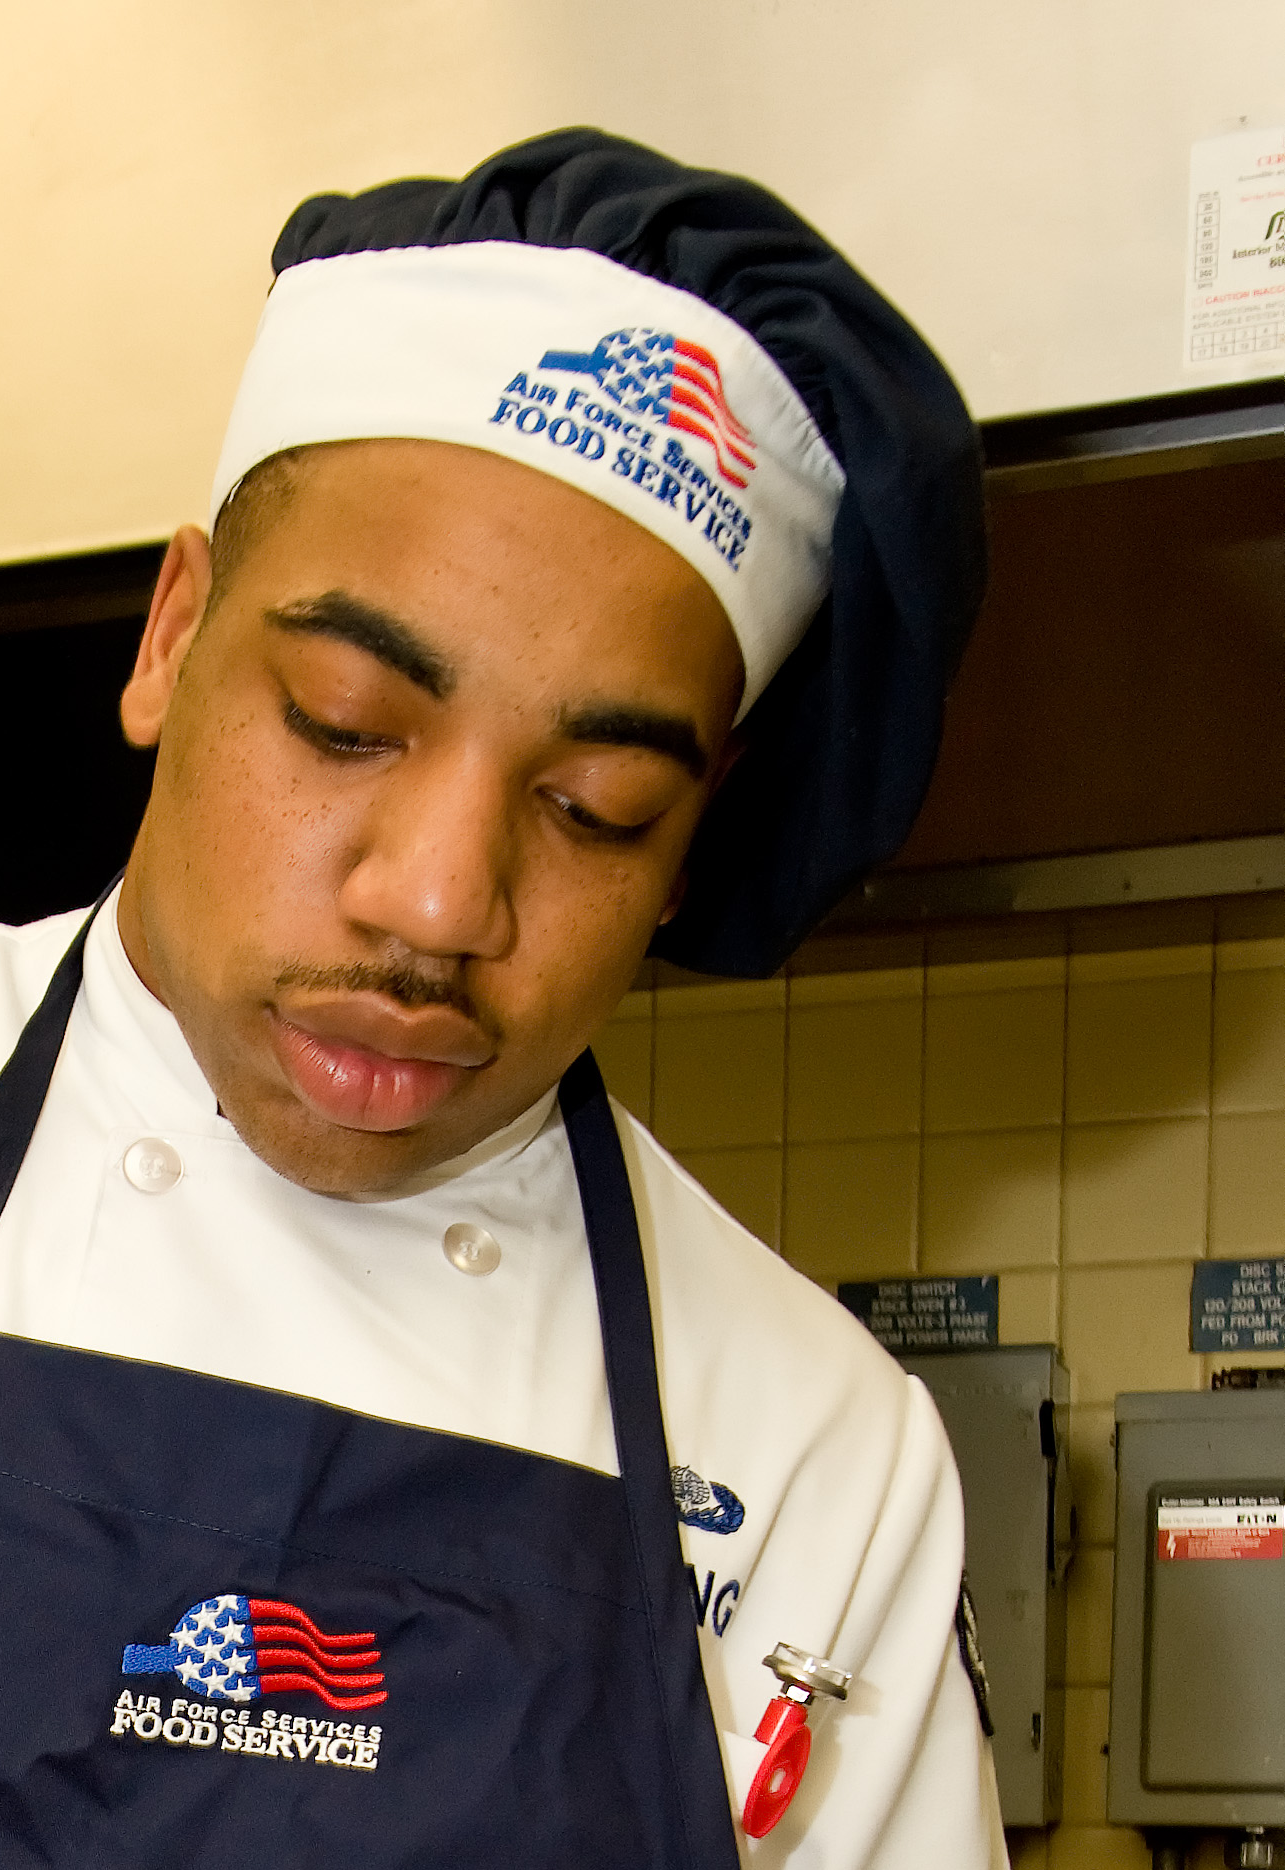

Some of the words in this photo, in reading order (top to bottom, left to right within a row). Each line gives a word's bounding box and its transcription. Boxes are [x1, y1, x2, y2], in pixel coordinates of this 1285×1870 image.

[488, 396, 607, 464] FOOD
[610, 446, 748, 574] SERVICE
[501, 370, 558, 407] AIR
[563, 386, 658, 452] FORCE
[661, 435, 754, 541] SERVICES
[1231, 1279, 1271, 1295] STACK
[1201, 1313, 1226, 1331] FED
[1229, 1312, 1266, 1330] FROM
[109, 1706, 218, 1747] FOOD
[220, 1723, 381, 1771] SERVICE
[116, 1688, 162, 1714] AIR
[171, 1697, 251, 1726] FORCE
[260, 1708, 384, 1745] SERVICES
